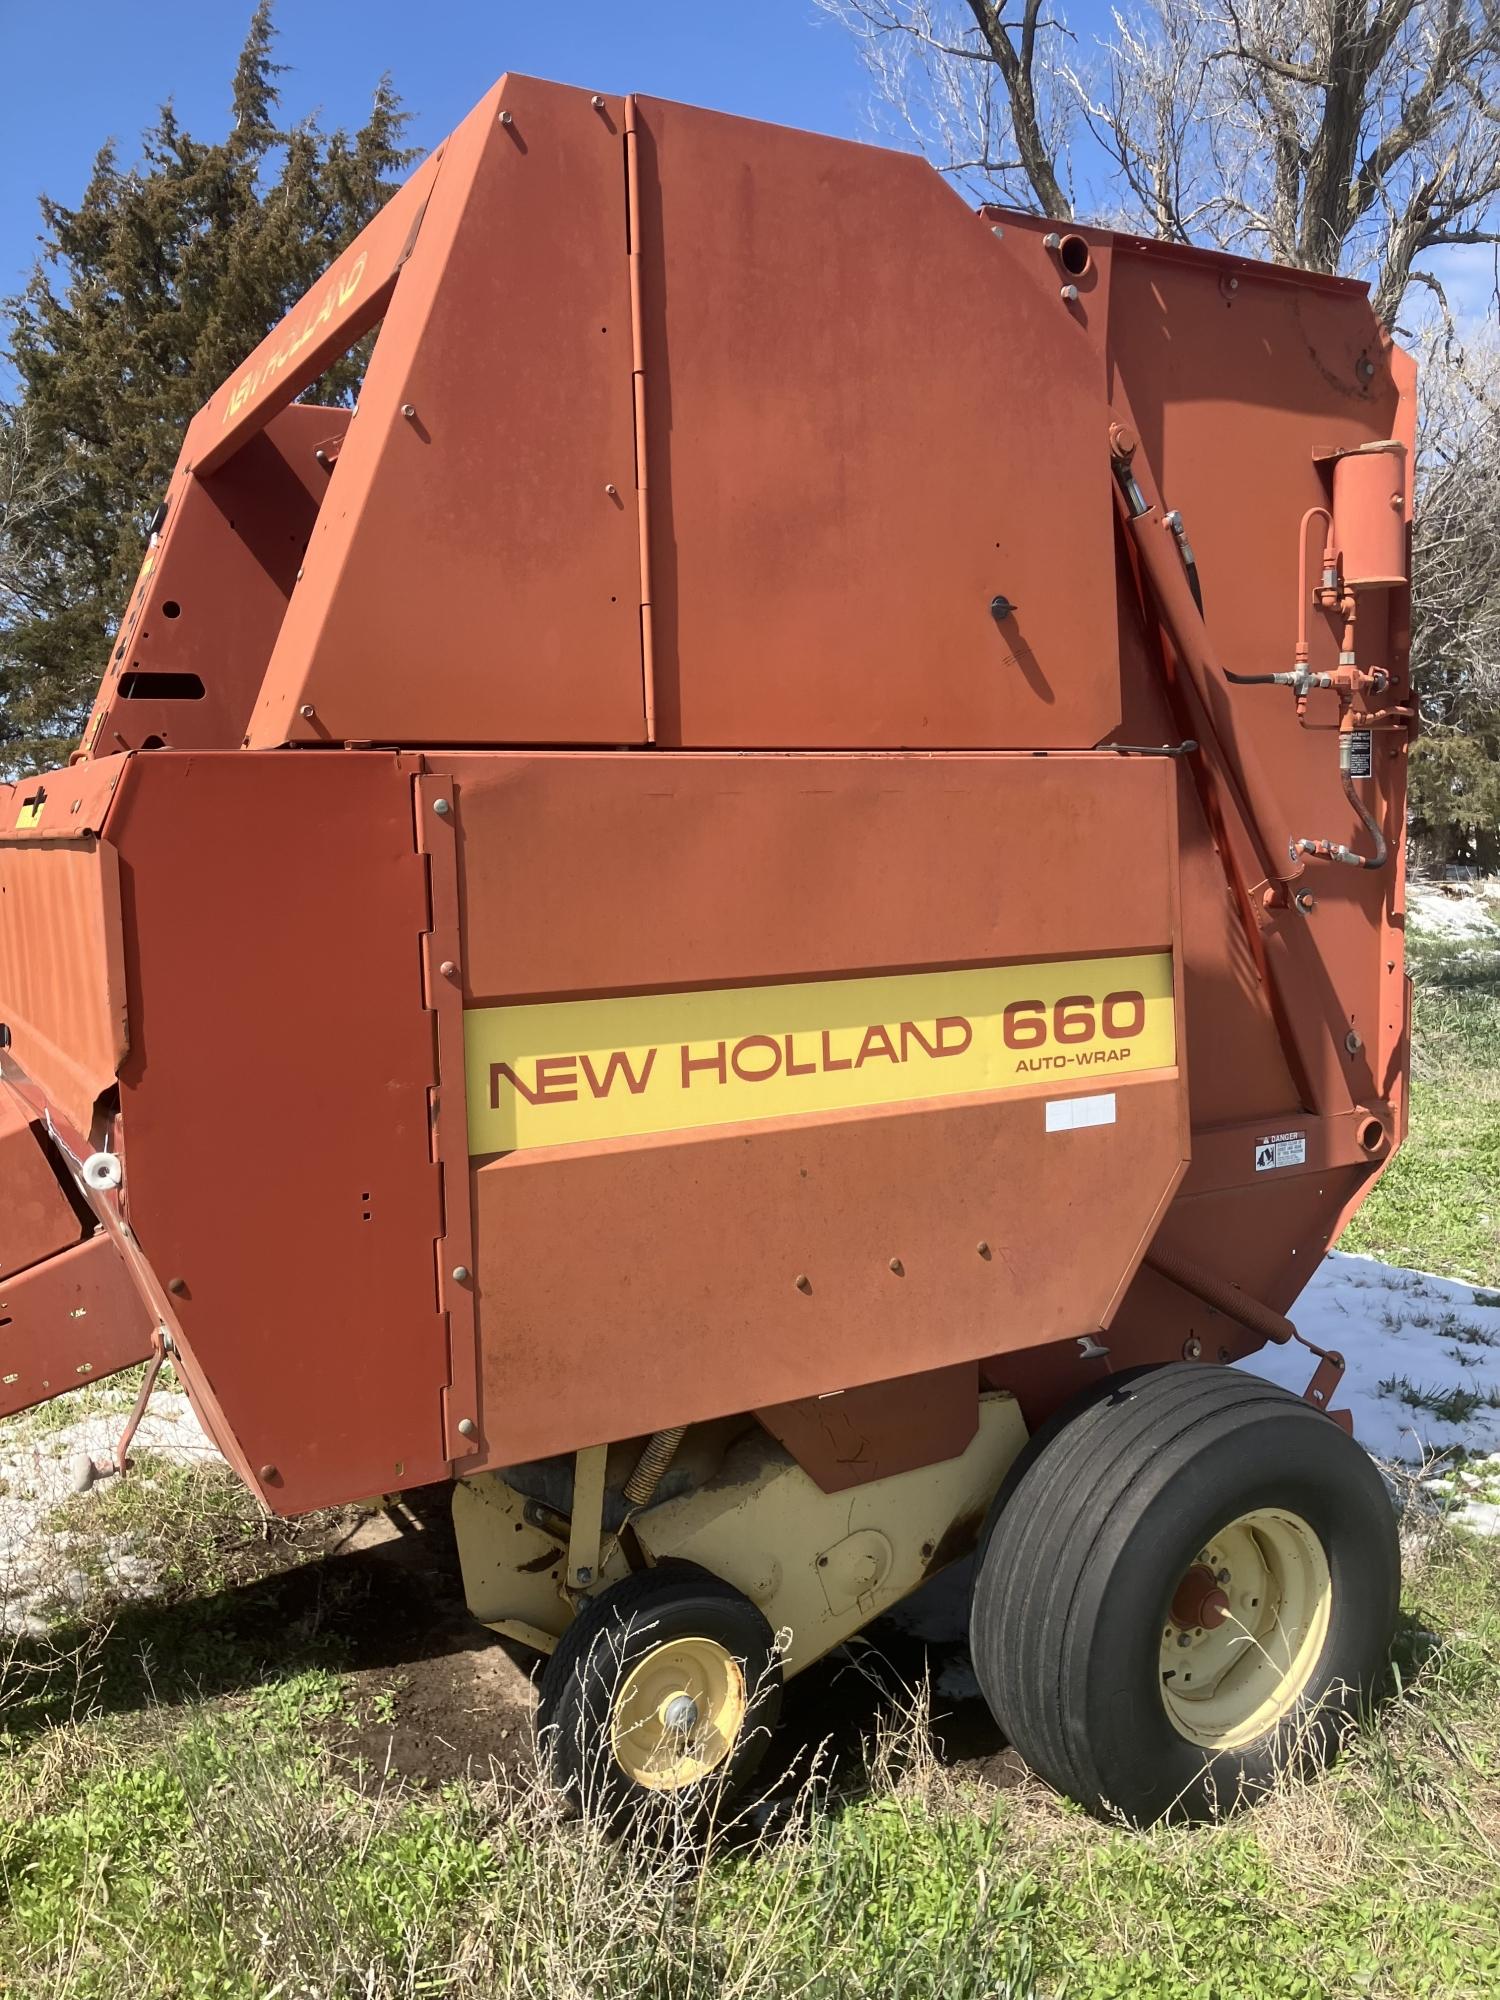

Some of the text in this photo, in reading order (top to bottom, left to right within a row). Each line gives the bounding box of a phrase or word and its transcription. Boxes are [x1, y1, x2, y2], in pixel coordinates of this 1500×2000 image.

[489, 990, 1146, 1110] NEW HOLLAND 660
[1015, 1048, 1131, 1073] AUTO-WRAP
[1271, 1132, 1298, 1143] DANGER
